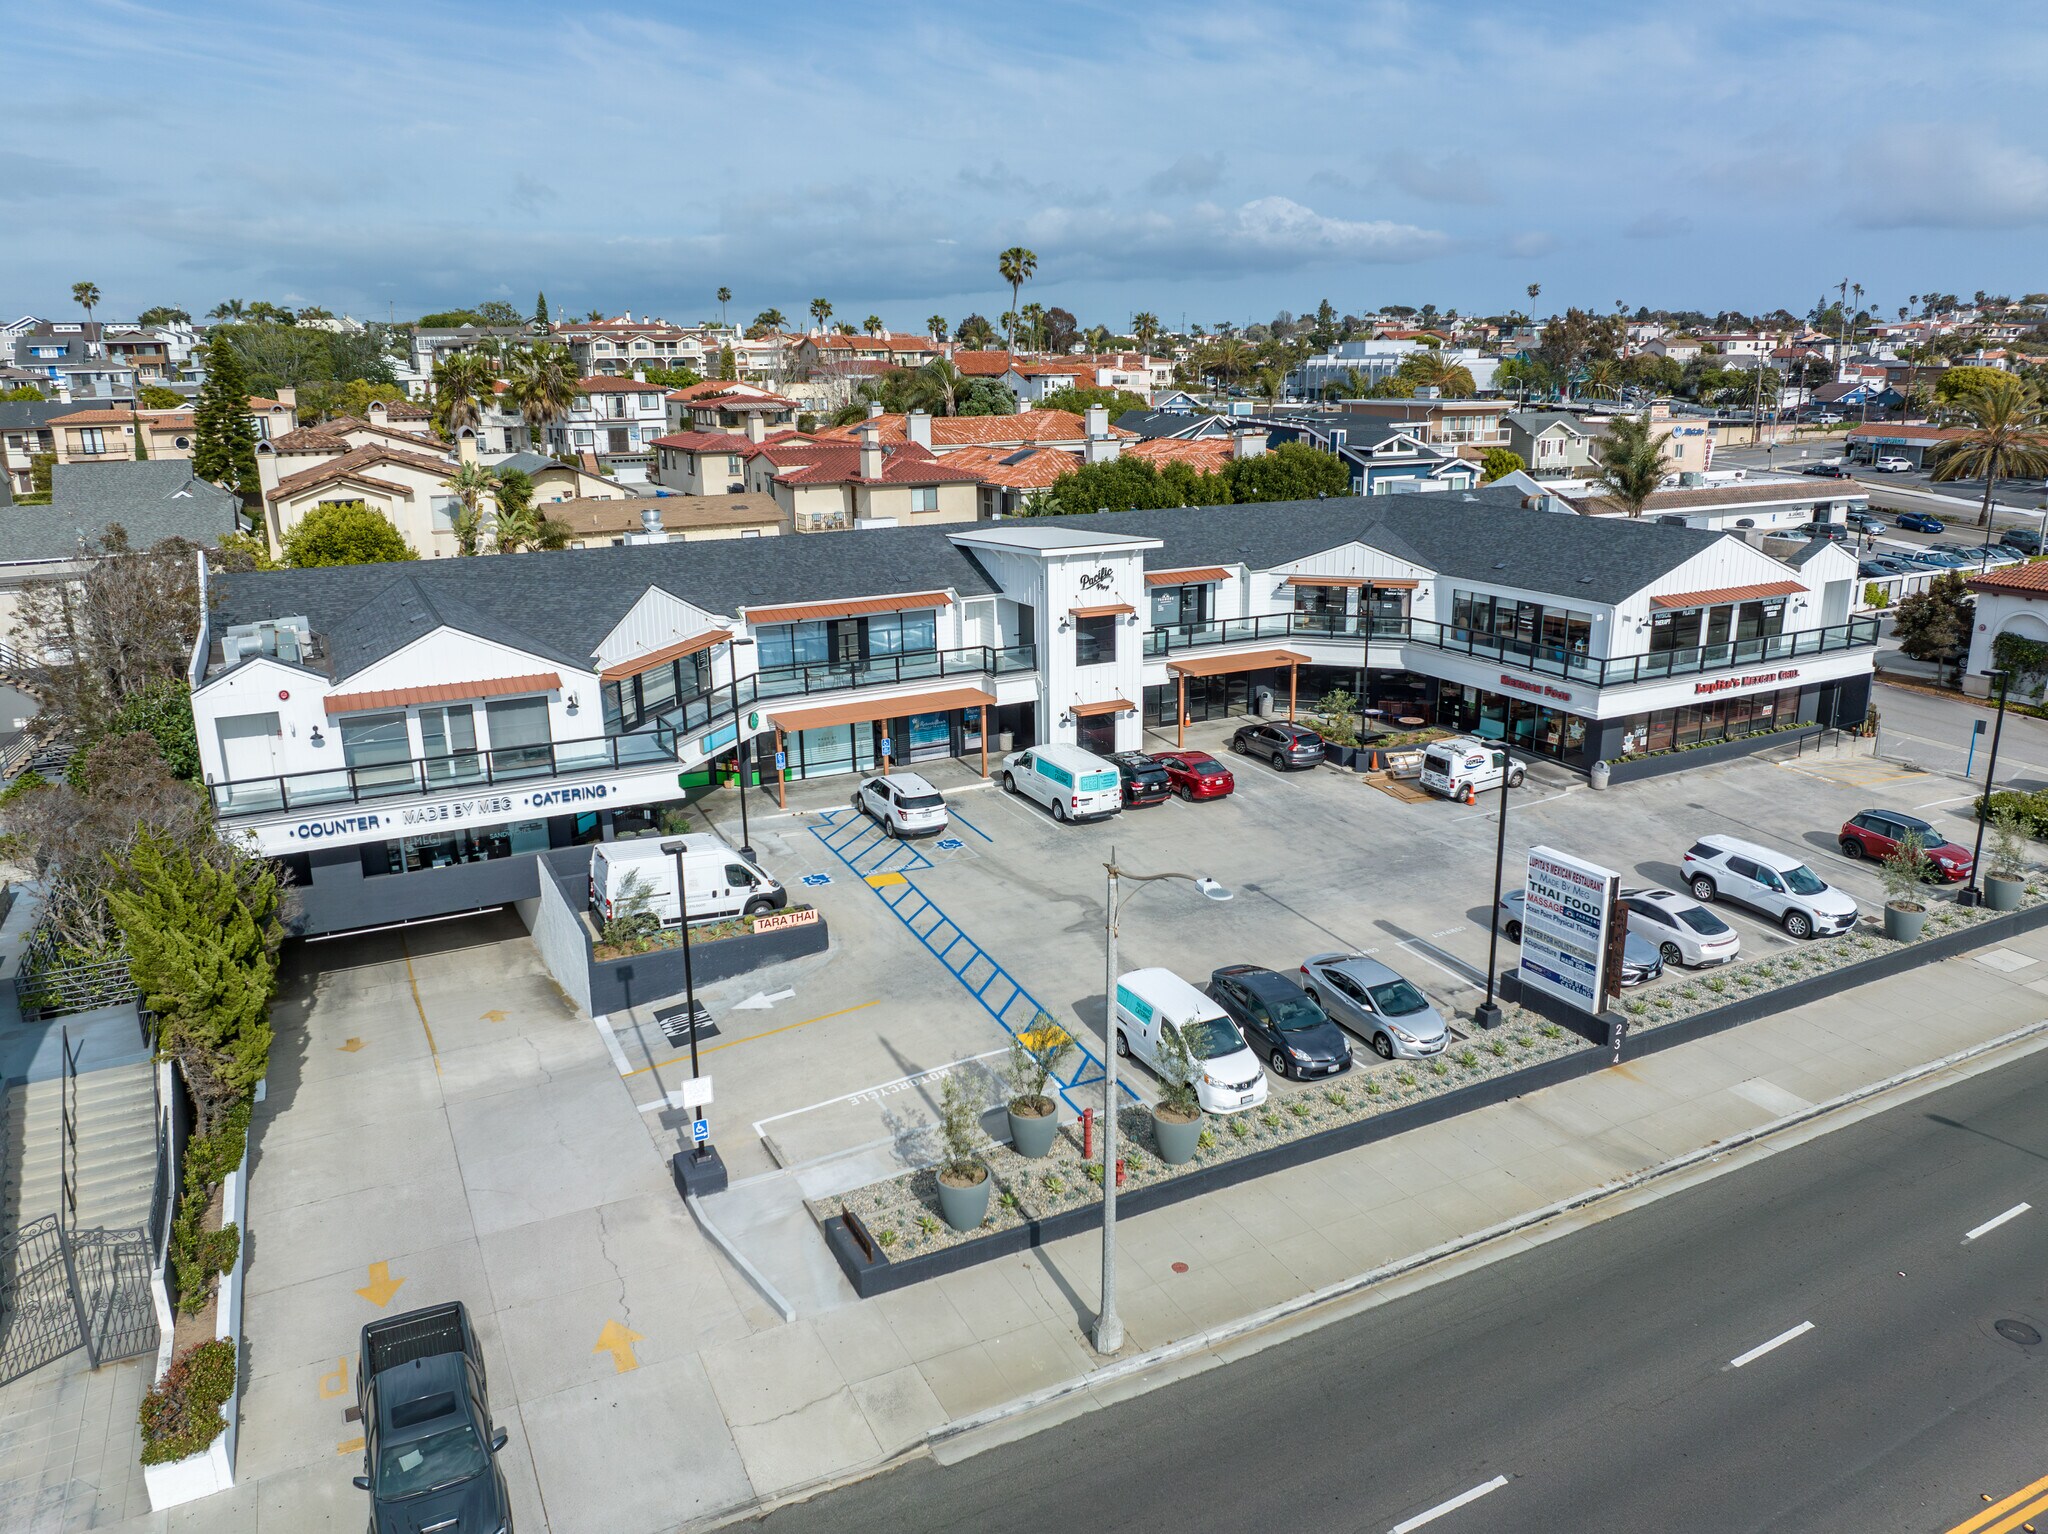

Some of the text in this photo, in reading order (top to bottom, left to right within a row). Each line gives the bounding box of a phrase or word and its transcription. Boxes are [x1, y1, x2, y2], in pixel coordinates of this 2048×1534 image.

[1703, 439, 1712, 472] MASSAG
[1080, 567, 1114, 590] Pacific
[532, 784, 607, 807] CATERING
[402, 796, 513, 825] MADE BY MEG
[298, 815, 380, 839] COUNTER
[1550, 864, 1571, 881] MEXICAN
[1572, 872, 1604, 893] RESTAURANT
[1527, 892, 1564, 914] MASSAGE
[1529, 881, 1601, 917] THAI FOOD
[758, 916, 787, 928] TARA
[789, 911, 815, 923] THAI
[1525, 903, 1540, 914] Ocean
[1553, 914, 1574, 929] Physical
[1576, 923, 1599, 940] Therapy
[1524, 937, 1557, 957] Acupuncture
[848, 1068, 951, 1106] MOTORCYCLE
